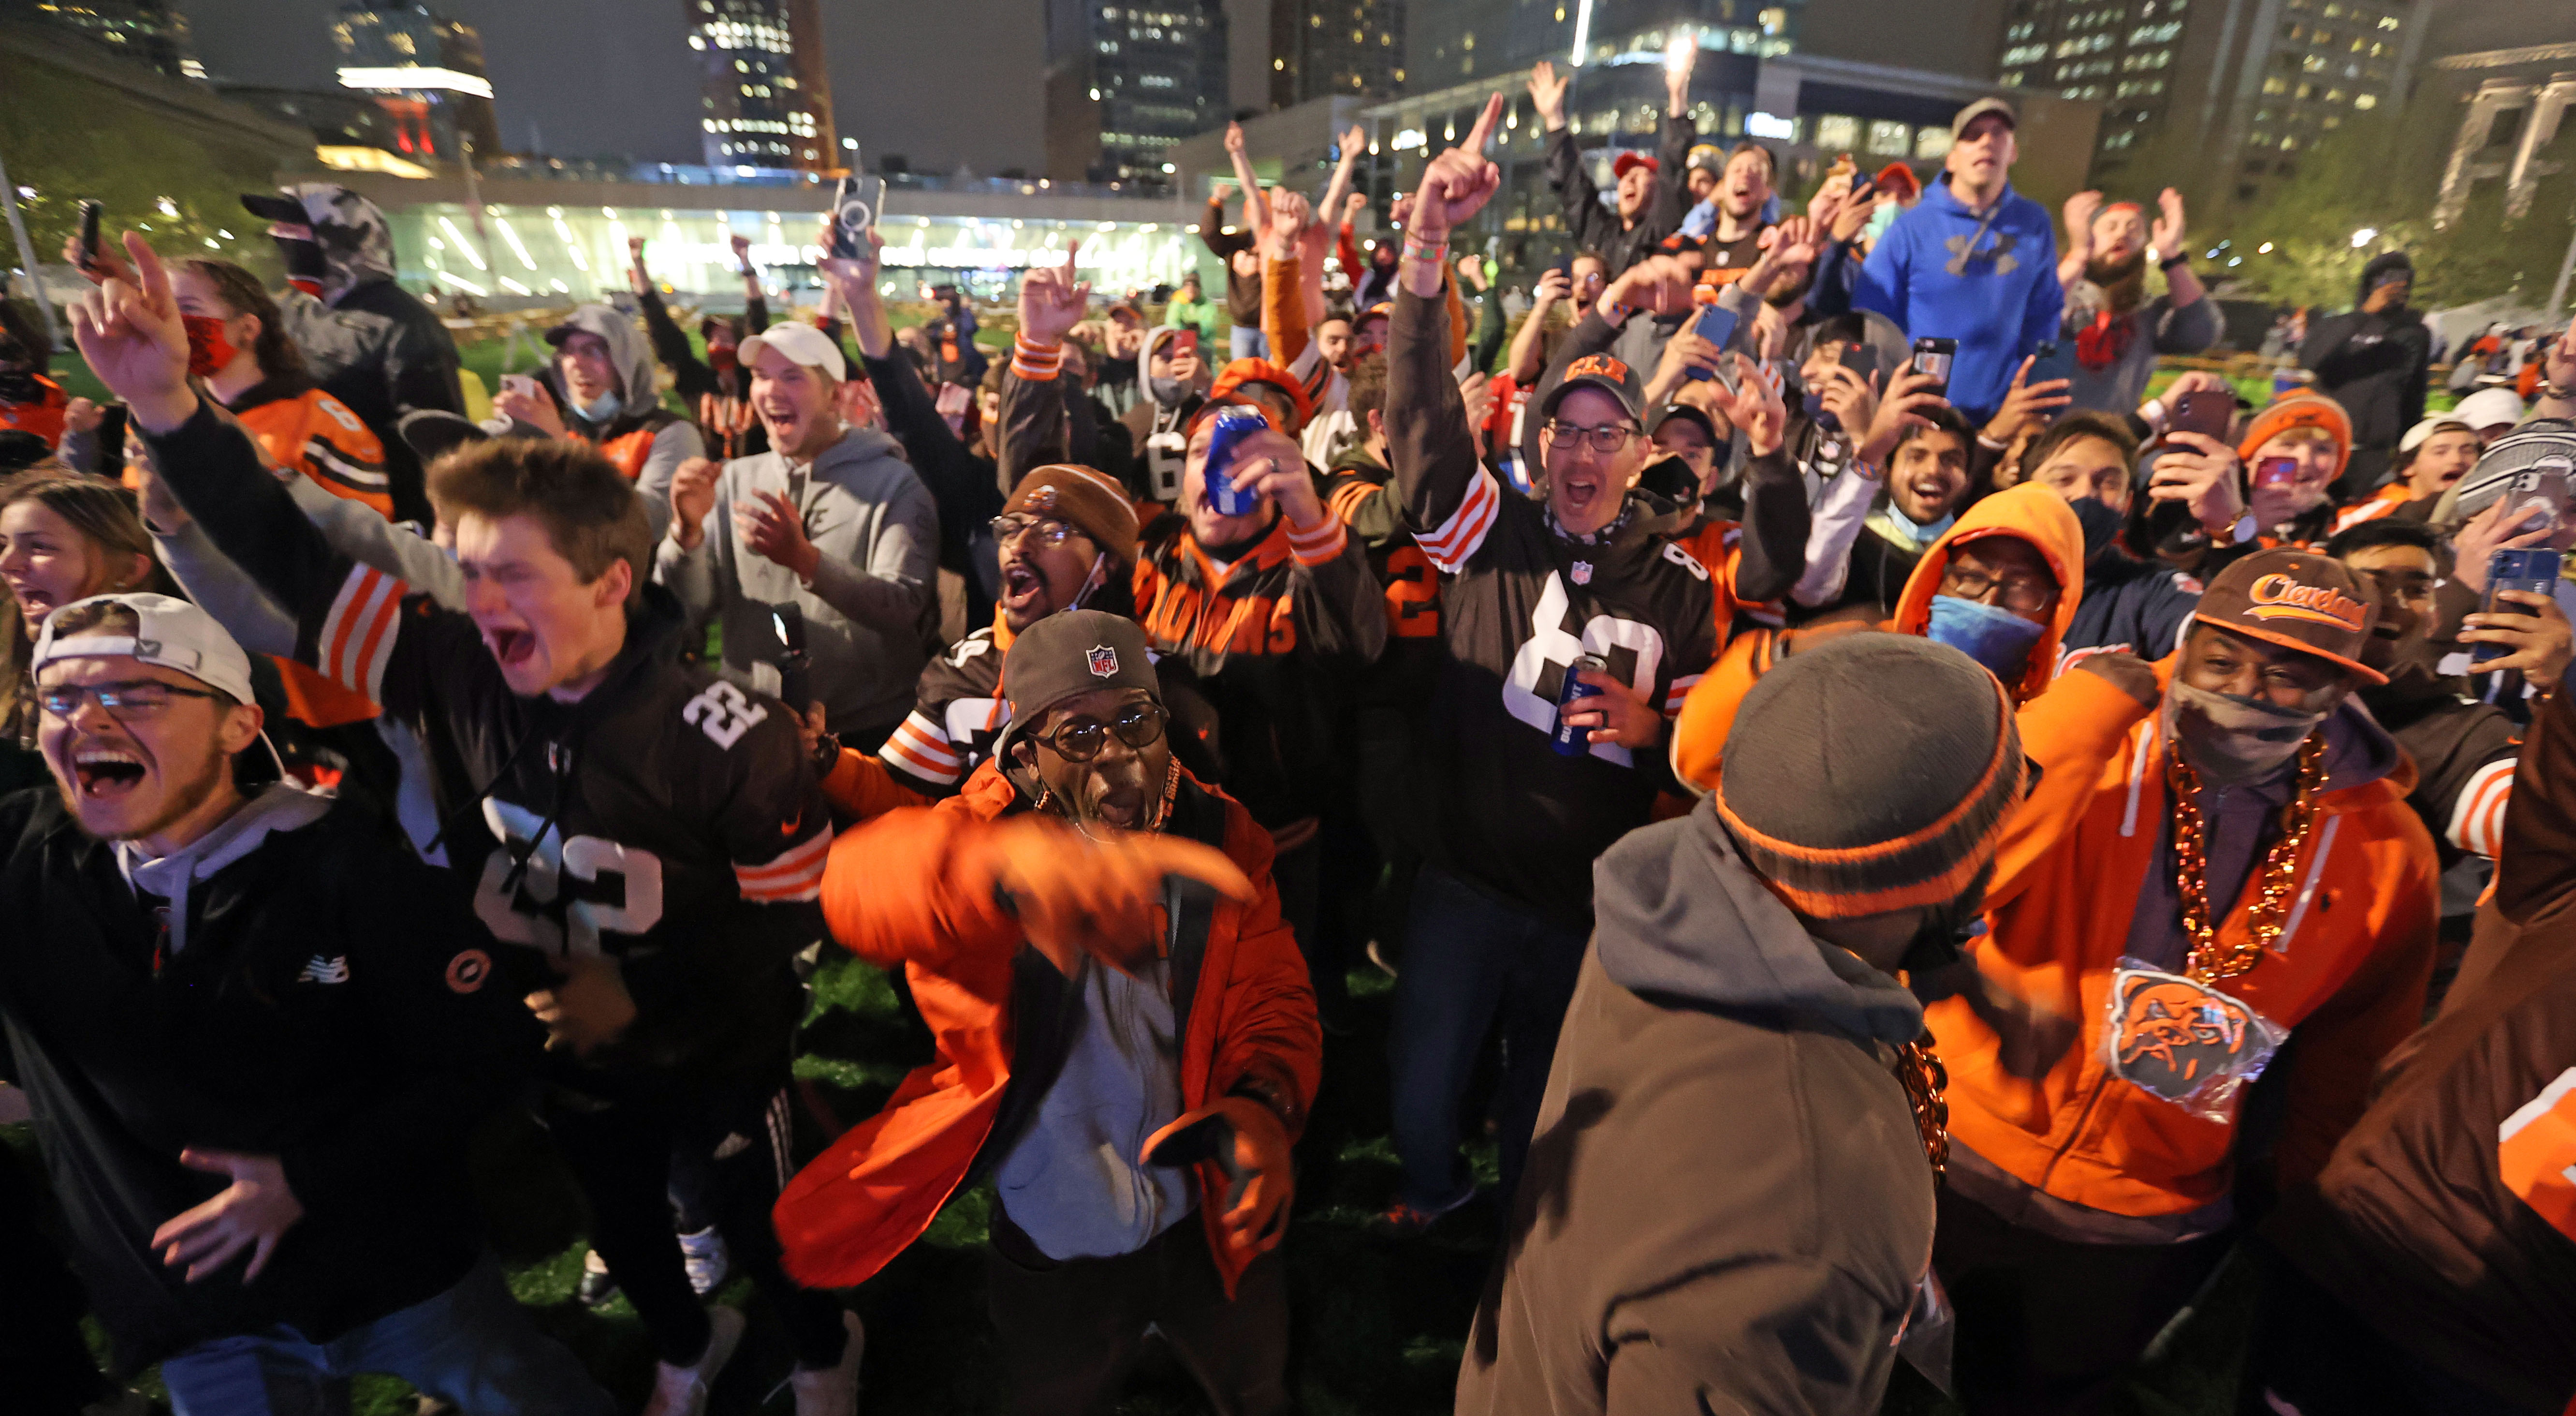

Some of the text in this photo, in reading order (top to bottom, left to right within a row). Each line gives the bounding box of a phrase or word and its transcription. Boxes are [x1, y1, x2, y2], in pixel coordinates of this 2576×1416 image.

[1564, 354, 1627, 385] CLE
[1146, 431, 1186, 501] 6
[1663, 542, 1710, 581] 8
[1092, 658, 1115, 673] NFL
[683, 680, 768, 751] 22
[473, 795, 664, 960] 22
